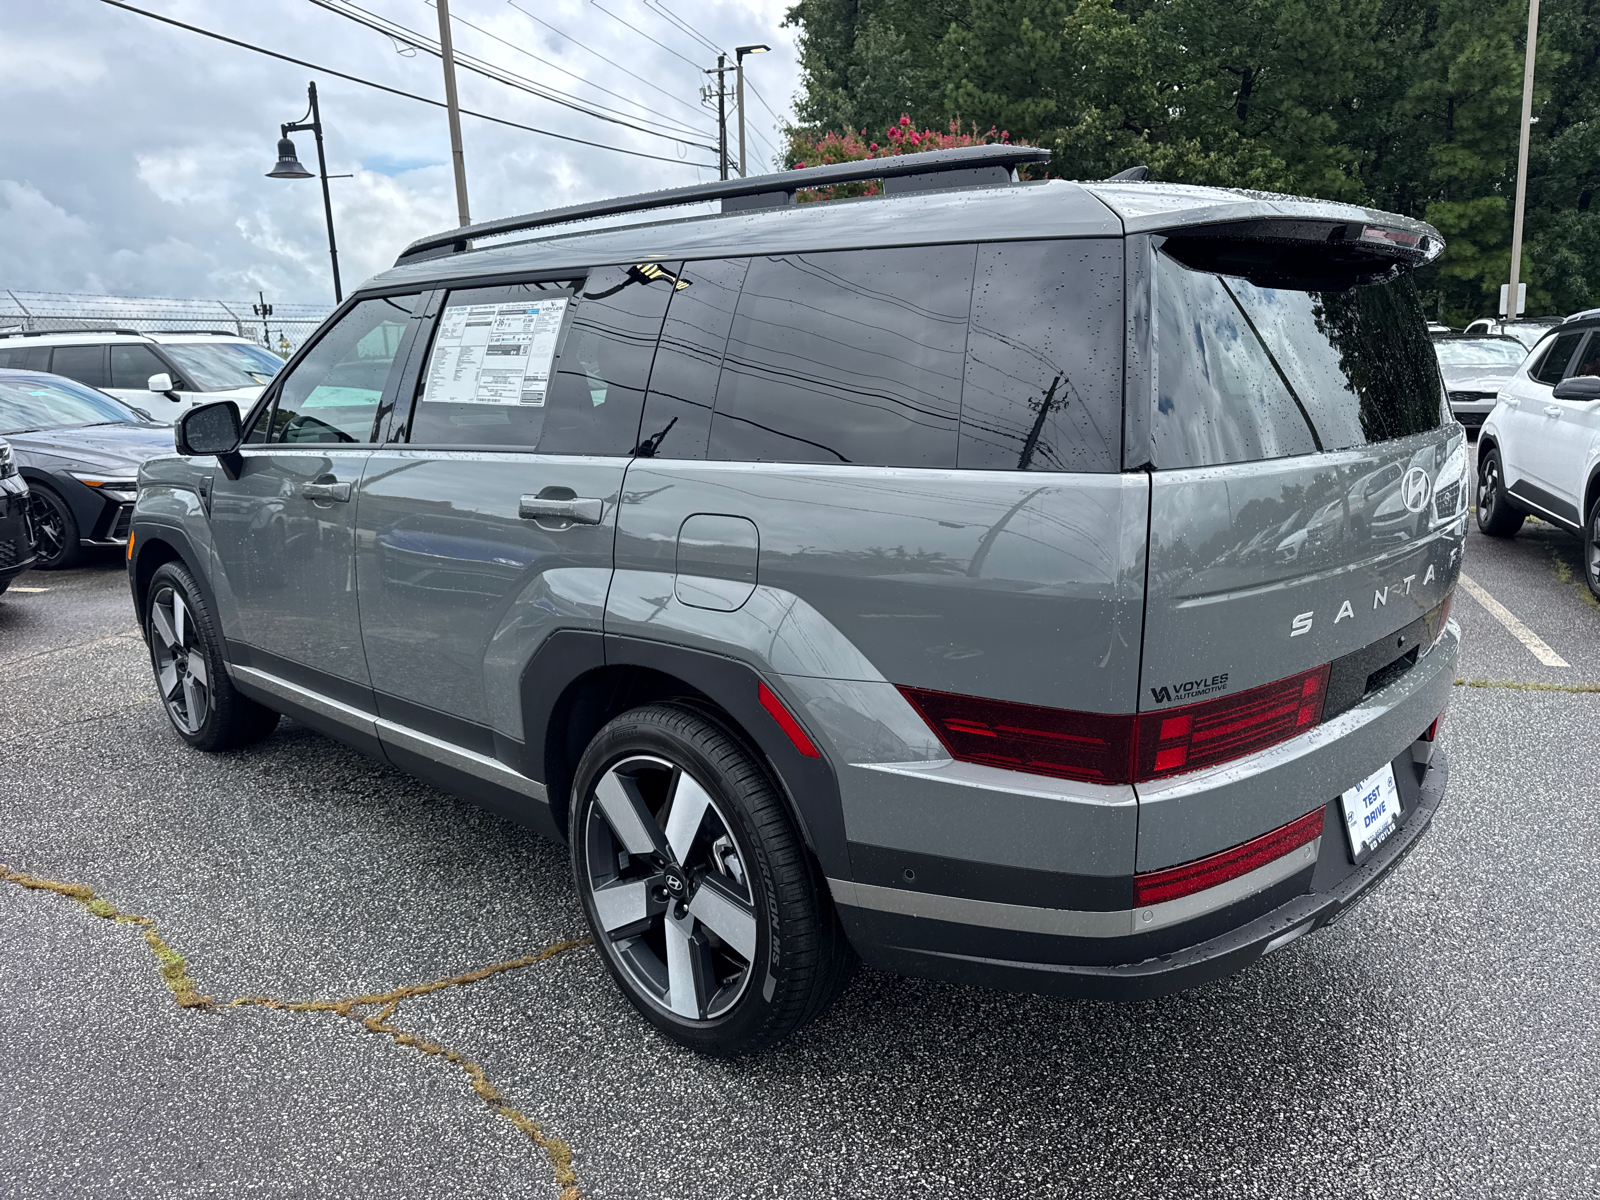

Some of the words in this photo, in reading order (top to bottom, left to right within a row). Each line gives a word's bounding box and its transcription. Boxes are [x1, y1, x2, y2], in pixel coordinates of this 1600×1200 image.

[1290, 564, 1435, 637] SANTA
[1173, 673, 1228, 694] VOYLES
[1173, 683, 1228, 702] AUTOMOTIVE
[1363, 785, 1380, 808] TEST
[1364, 800, 1386, 828] DRIVE
[1370, 840, 1378, 851] ED
[1377, 822, 1396, 844] VOYLES
[743, 821, 780, 930] SCORPION
[771, 934, 781, 967] MS
